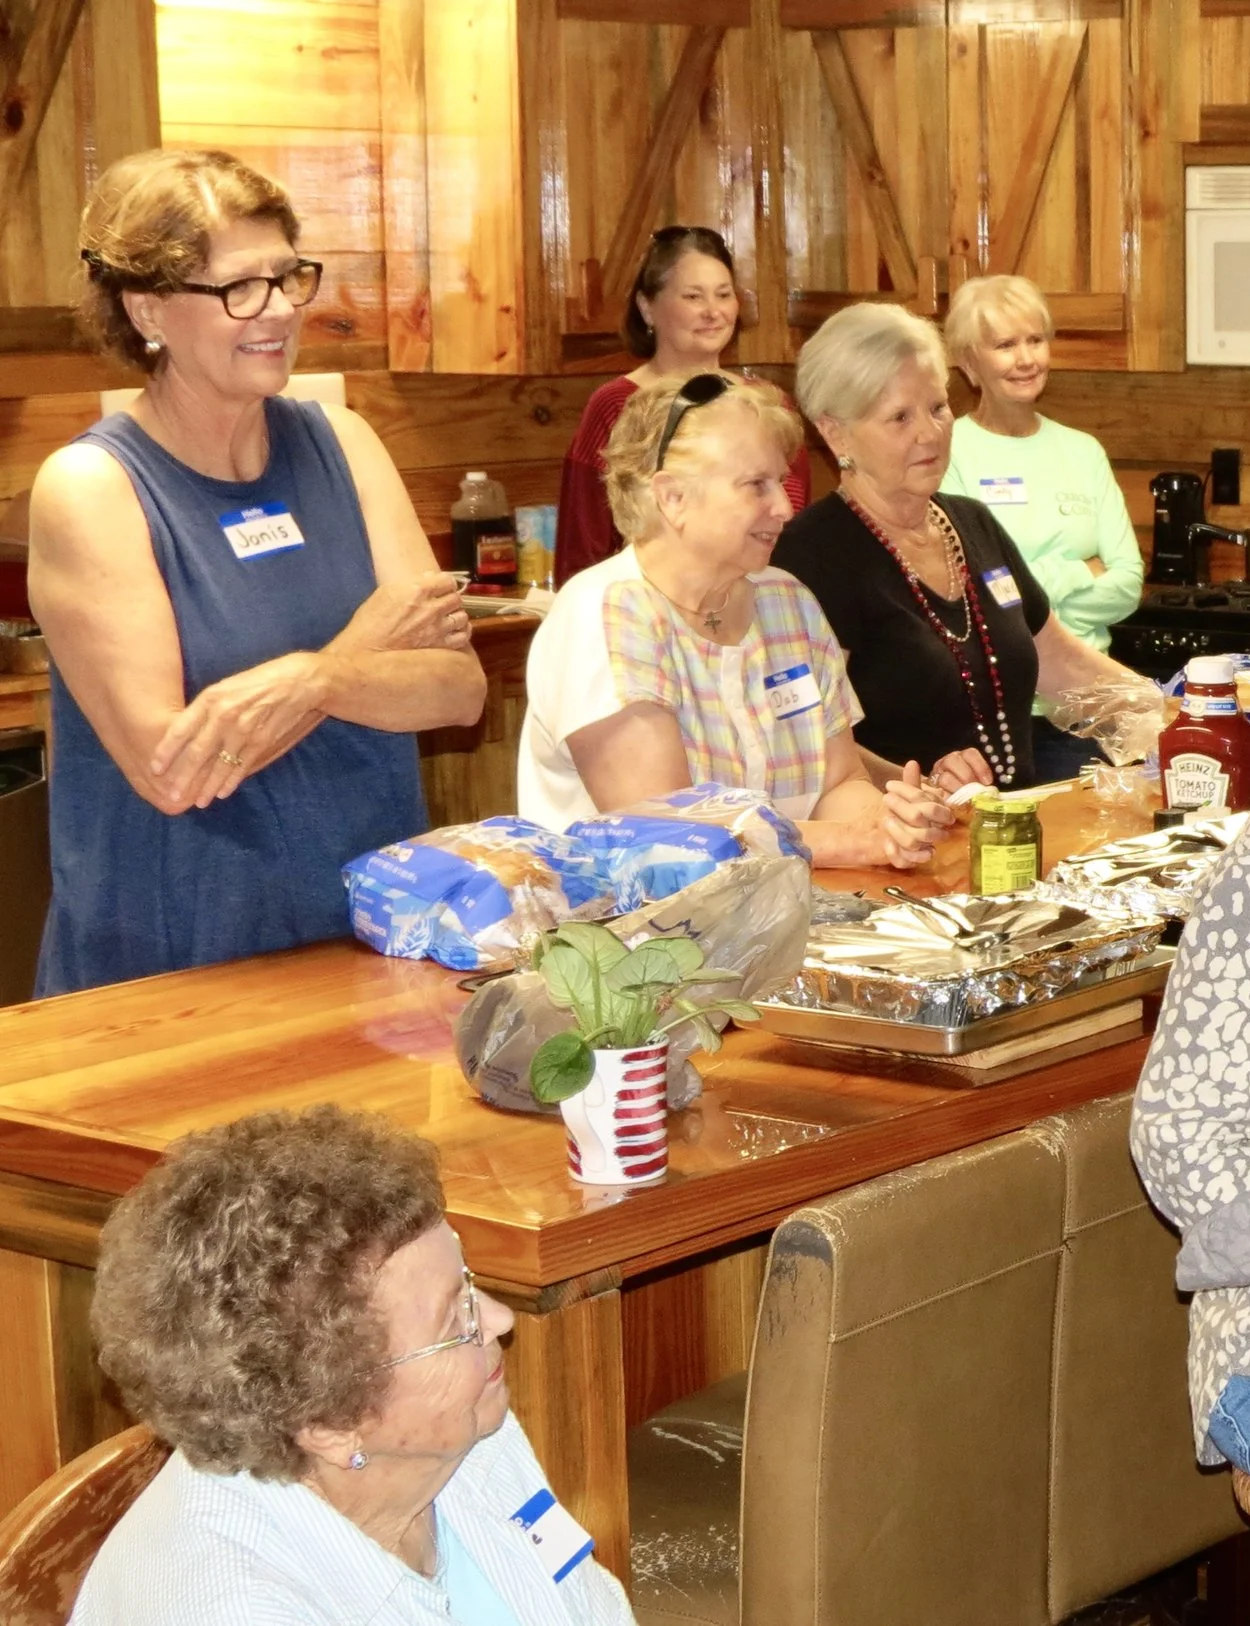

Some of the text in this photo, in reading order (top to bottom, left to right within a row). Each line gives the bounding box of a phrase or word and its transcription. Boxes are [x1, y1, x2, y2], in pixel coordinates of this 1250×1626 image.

[1178, 762, 1210, 776] HEINZ
[1174, 778, 1216, 791] TOMATO
[1176, 788, 1214, 799] KETCHUP
